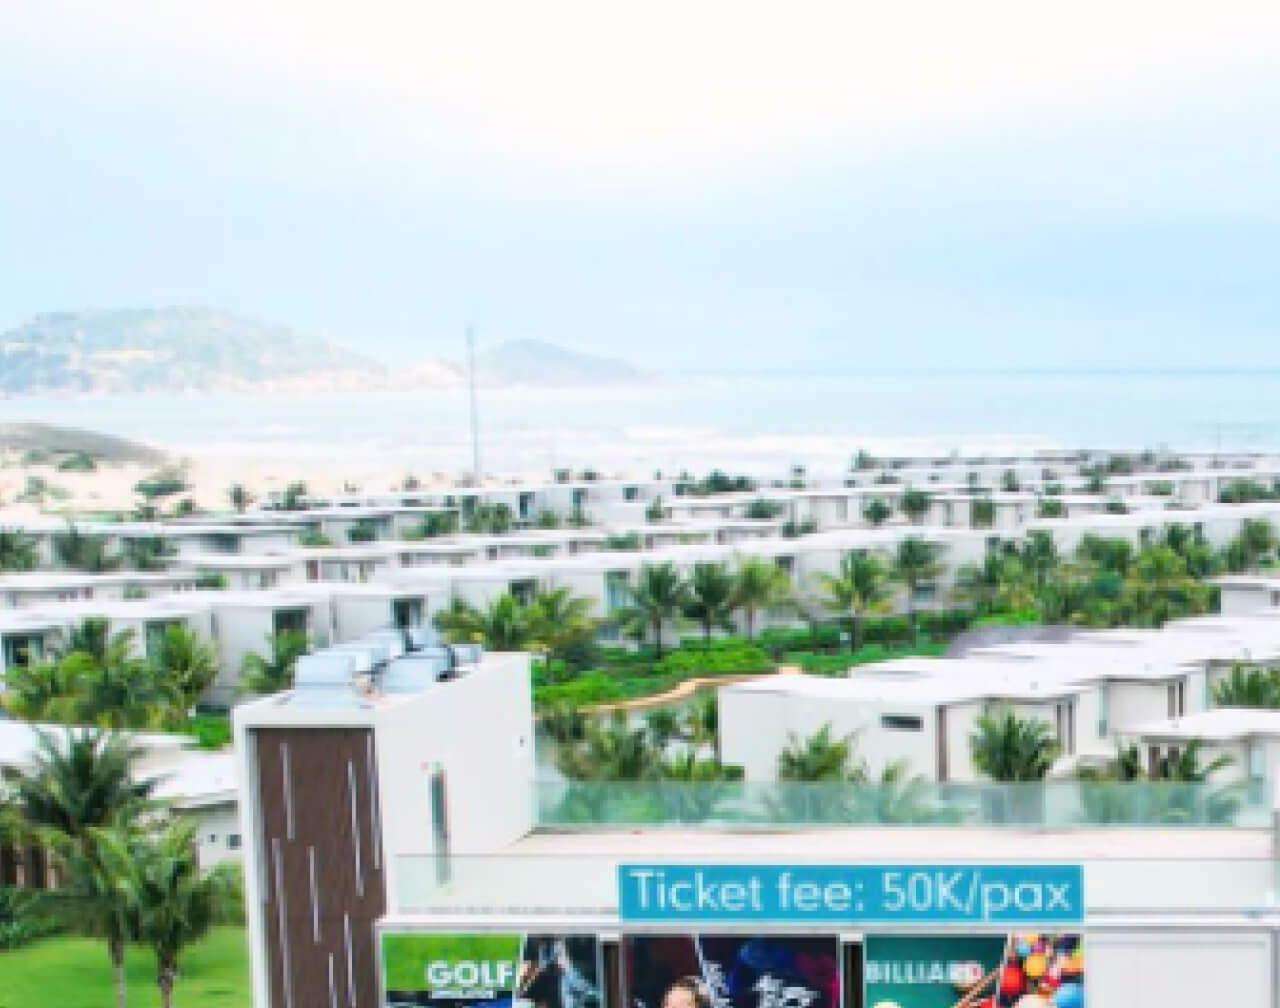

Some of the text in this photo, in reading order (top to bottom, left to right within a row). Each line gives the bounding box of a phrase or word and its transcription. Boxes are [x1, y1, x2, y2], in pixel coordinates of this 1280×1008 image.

[629, 870, 1072, 921] Ticket fee: 50K/pax
[427, 960, 519, 985] GOLF
[865, 961, 984, 983] BILLIARD
